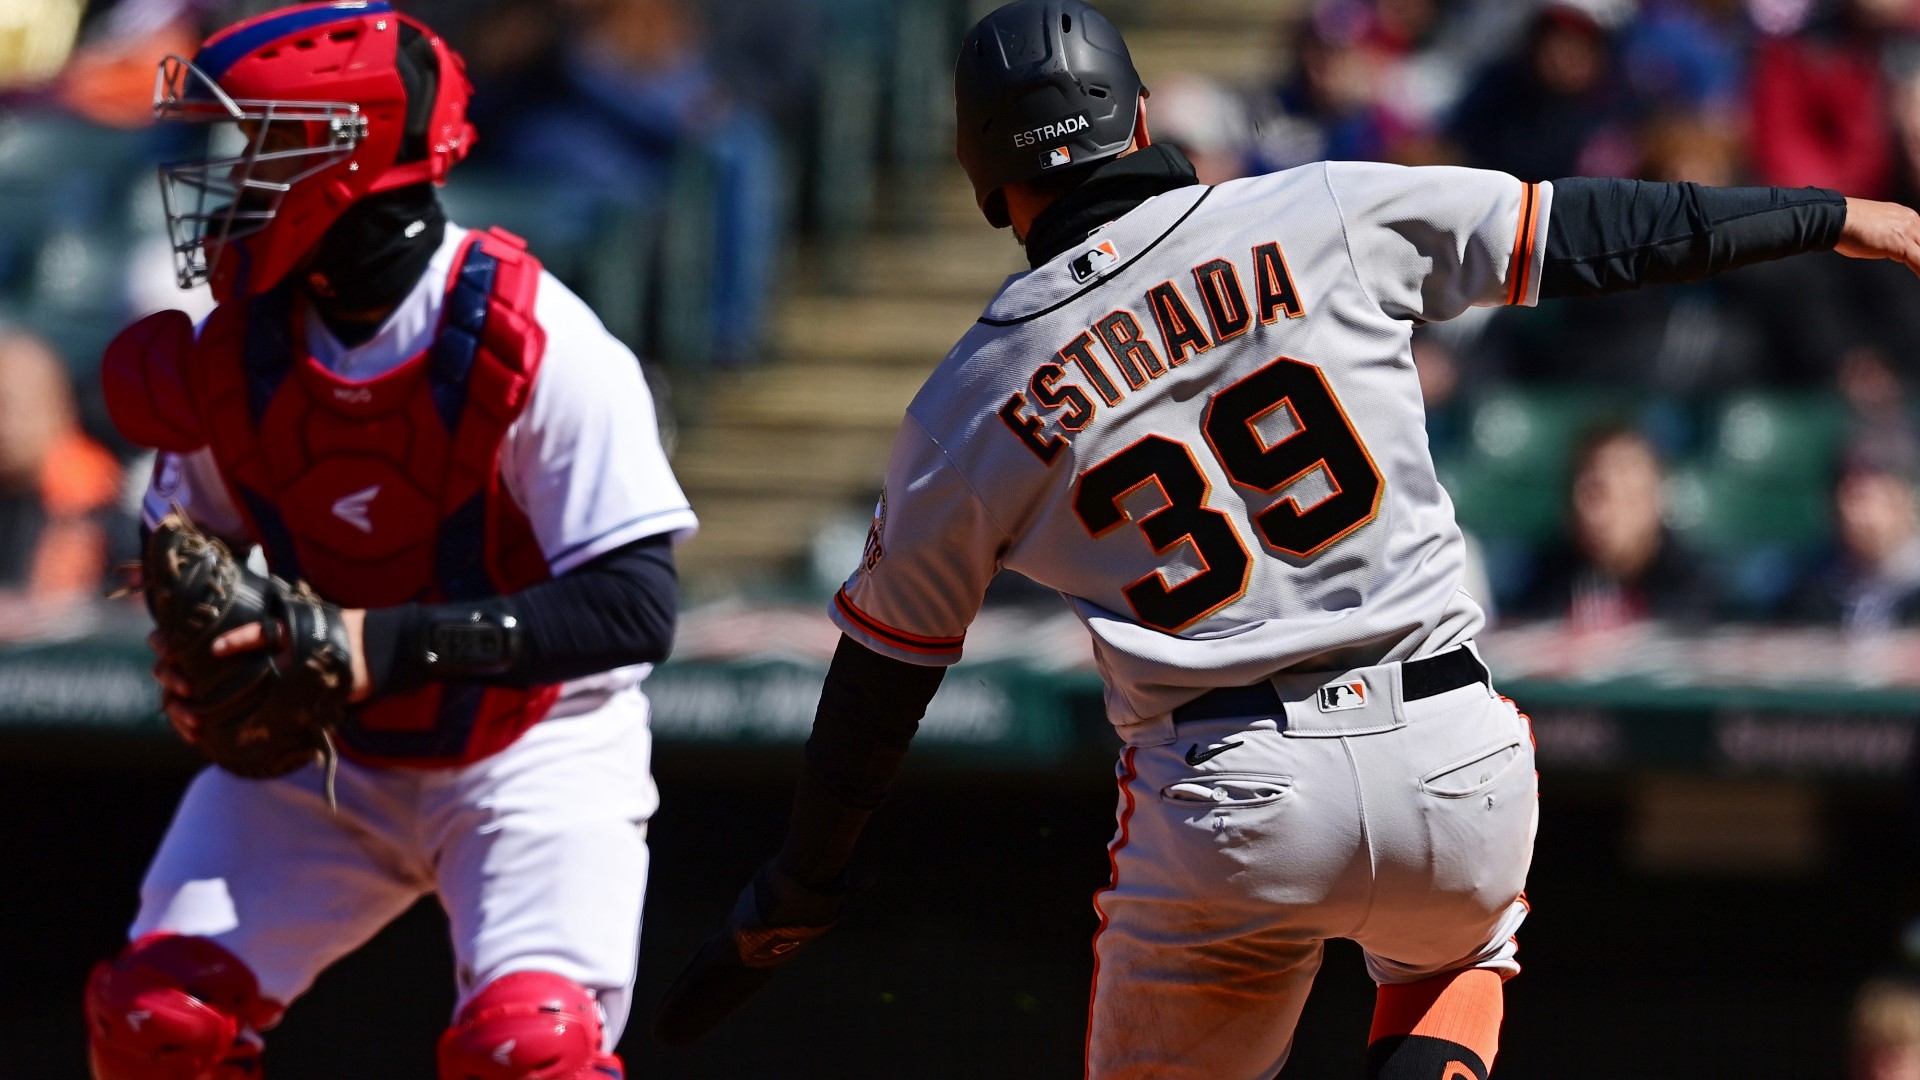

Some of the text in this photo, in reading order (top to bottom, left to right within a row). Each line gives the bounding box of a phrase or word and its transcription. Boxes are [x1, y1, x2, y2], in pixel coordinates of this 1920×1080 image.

[1013, 114, 1090, 148] ESTRADA
[997, 241, 1305, 467] ESTRADA
[1072, 356, 1386, 634] 39
